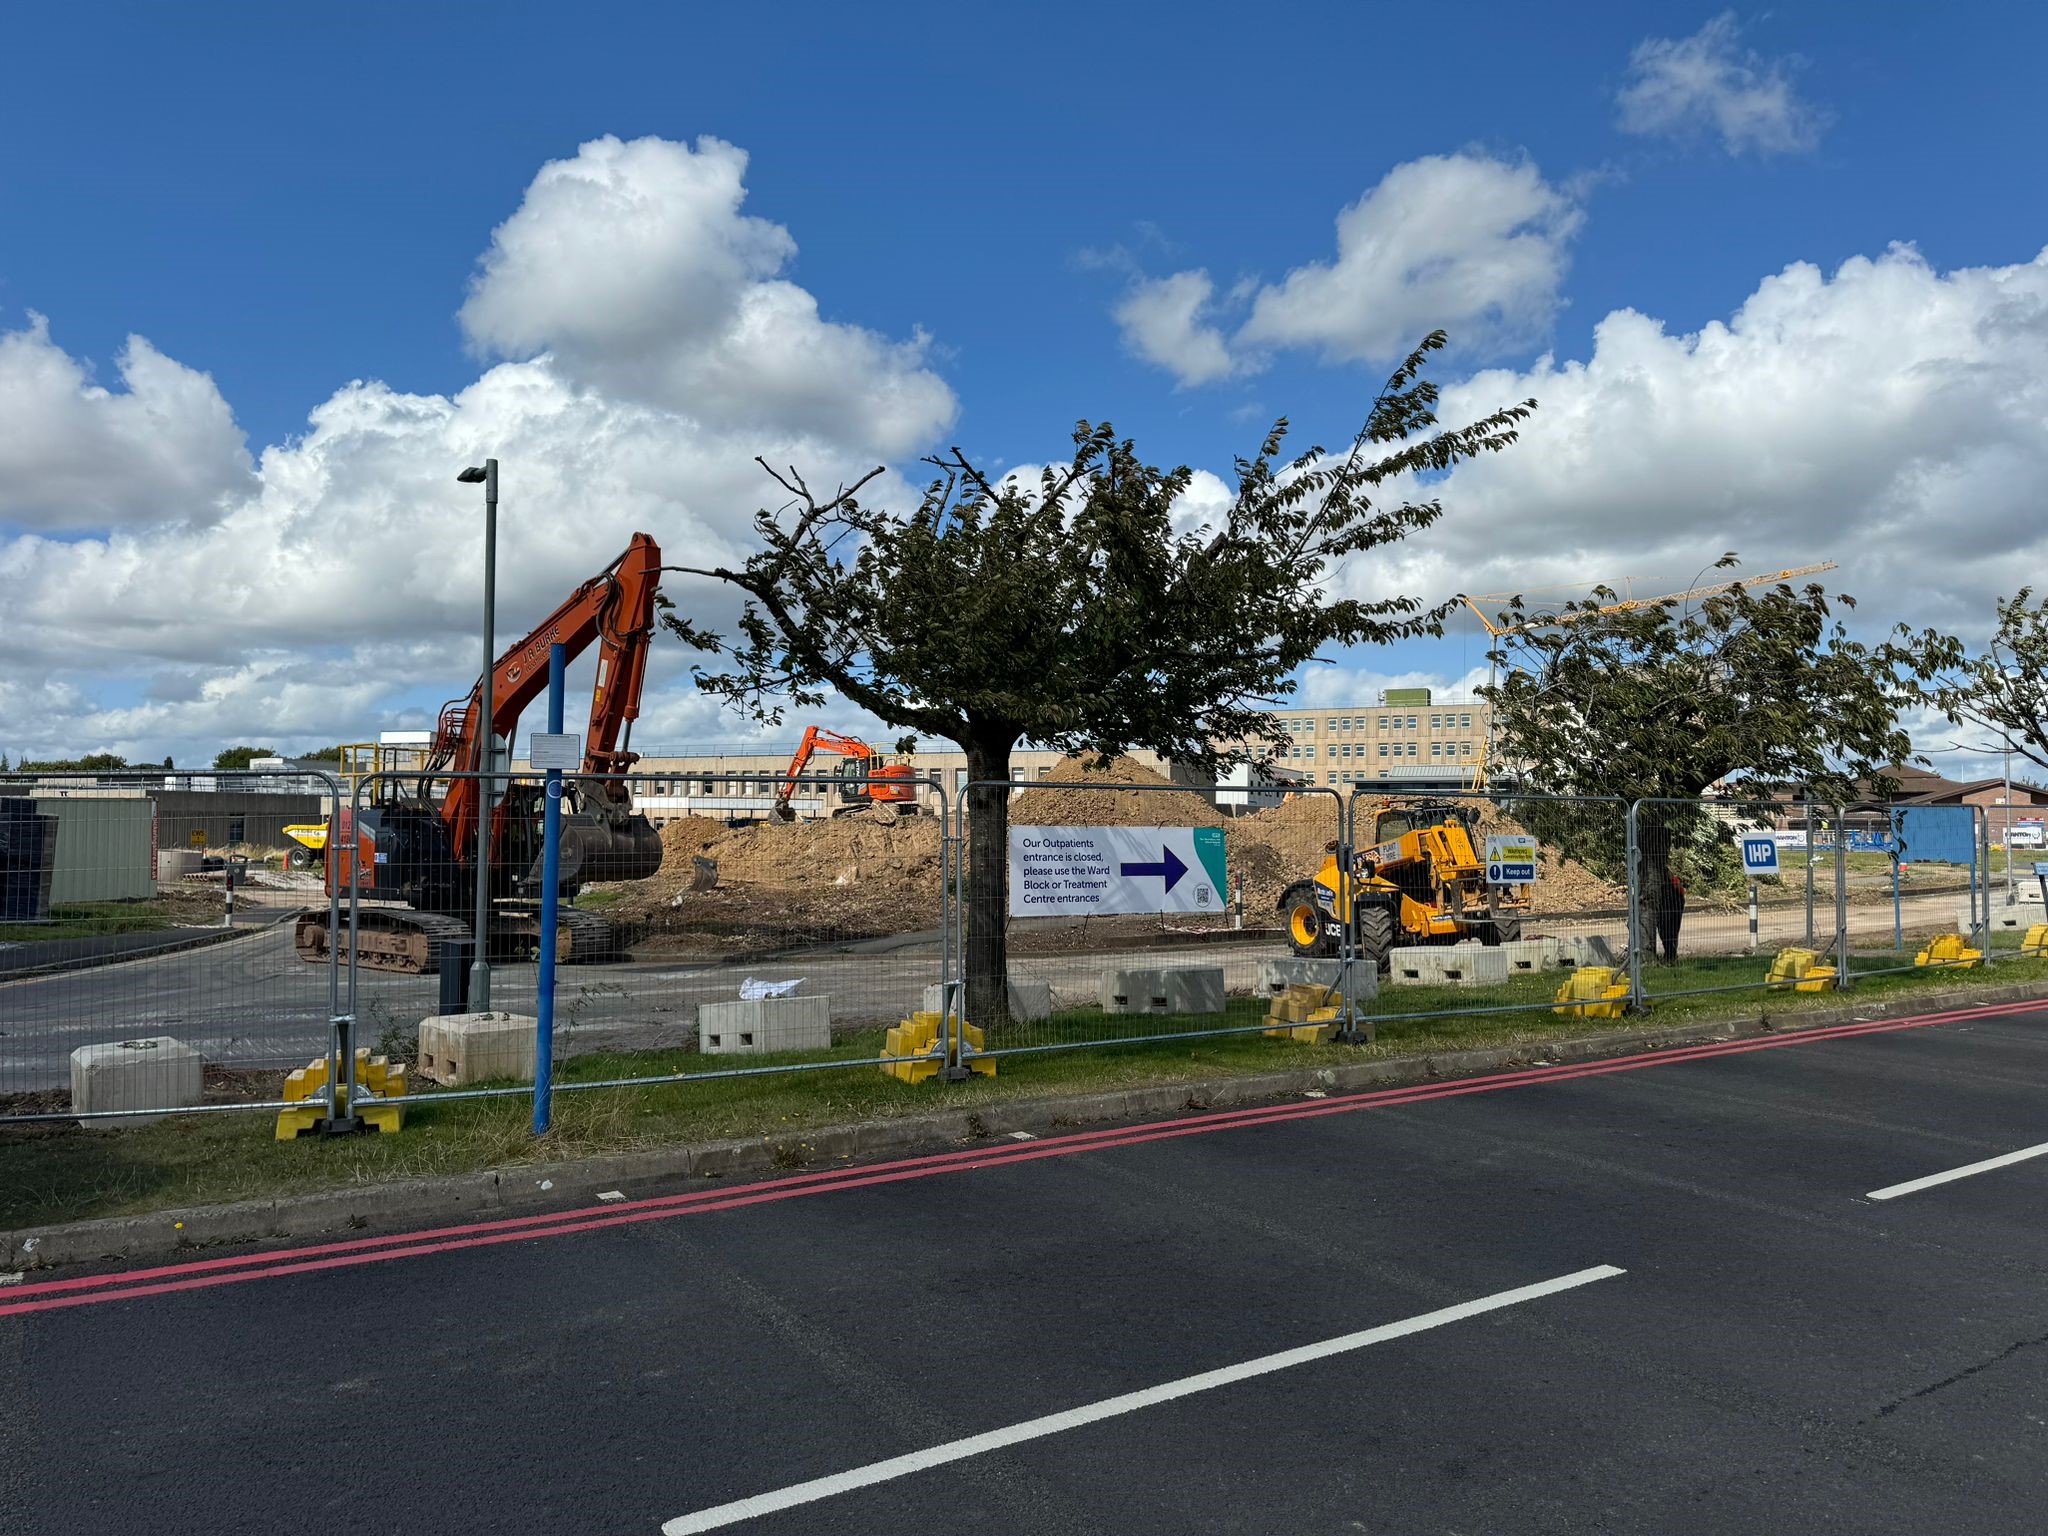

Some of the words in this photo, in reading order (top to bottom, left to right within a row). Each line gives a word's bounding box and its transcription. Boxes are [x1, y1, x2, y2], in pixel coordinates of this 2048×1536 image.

[535, 624, 560, 653] BURKE
[1023, 838, 1041, 848] Our
[1043, 838, 1094, 850] Outpatients
[1023, 853, 1064, 862] entrance
[1065, 852, 1072, 862] is
[1073, 852, 1104, 863] closed,
[1748, 844, 1772, 863] IHP
[1023, 866, 1053, 878] please
[1054, 868, 1070, 876] use
[1071, 866, 1086, 875] the
[1087, 865, 1110, 875] Ward
[1505, 867, 1520, 877] Keep
[1521, 868, 1531, 876] out
[1023, 880, 1050, 890] Block
[1063, 879, 1107, 889] Treatment
[1023, 894, 1056, 903] Centre
[1057, 894, 1100, 903] entrances
